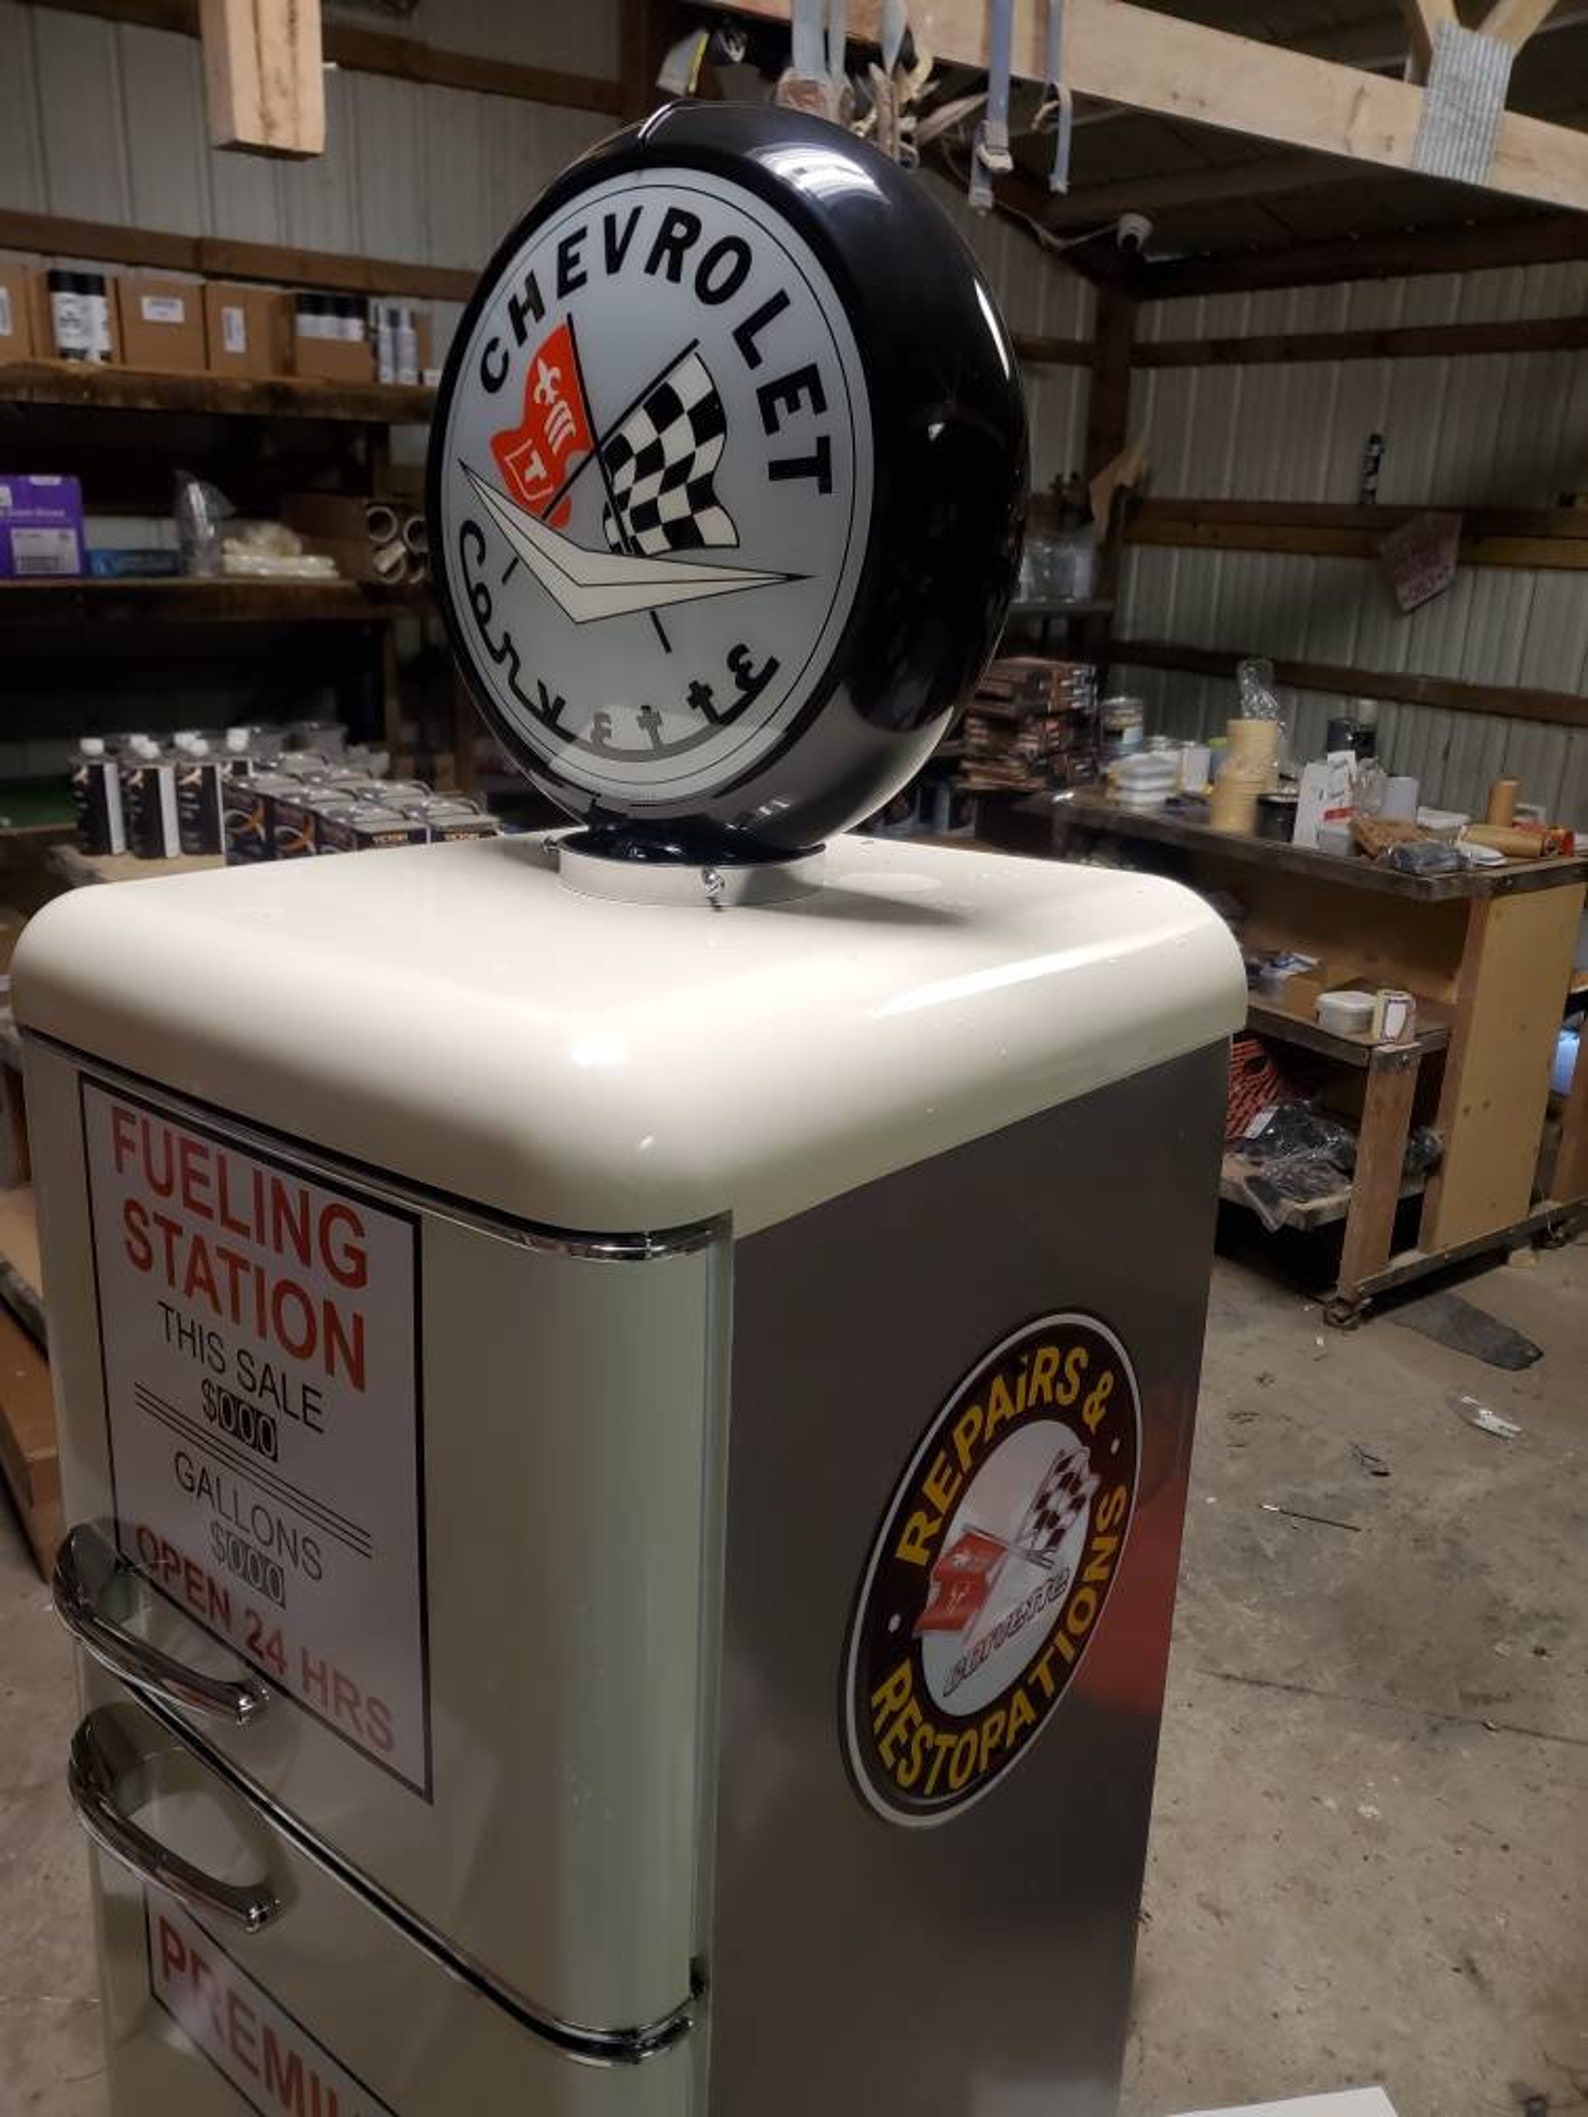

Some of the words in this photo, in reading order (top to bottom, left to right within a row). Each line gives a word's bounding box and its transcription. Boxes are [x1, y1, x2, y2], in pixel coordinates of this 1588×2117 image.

[479, 206, 832, 494] CHEVROLET
[111, 1105, 368, 1289] FUELING
[123, 1199, 365, 1392] STATION
[157, 1300, 226, 1375] THIS
[236, 1348, 324, 1434] SALE
[1081, 1371, 1115, 1434] &
[174, 1452, 322, 1580] GALLONS
[137, 1525, 231, 1633] OPEN
[246, 1610, 288, 1678] 24
[302, 1648, 394, 1753] HRS
